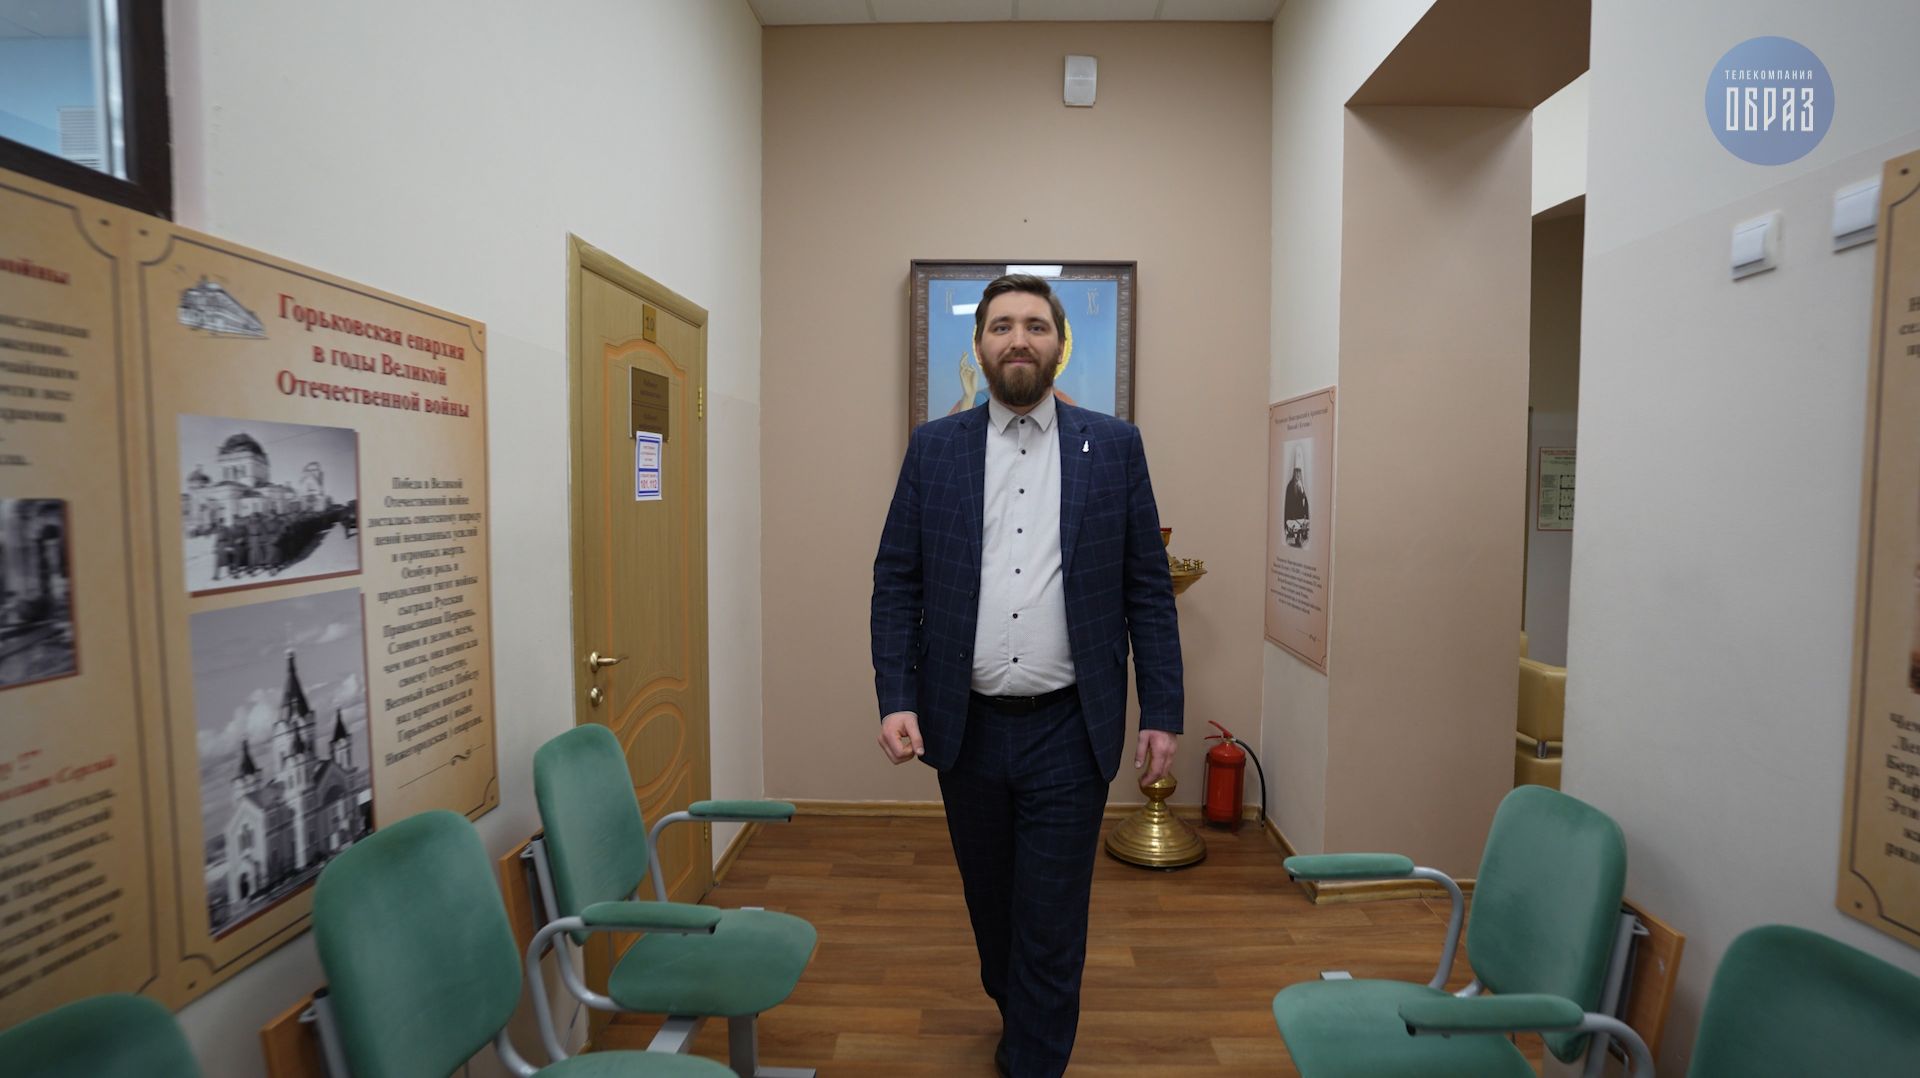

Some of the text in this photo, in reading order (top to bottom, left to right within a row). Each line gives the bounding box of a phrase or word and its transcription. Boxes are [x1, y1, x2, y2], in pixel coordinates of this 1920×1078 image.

[278, 293, 465, 361] Горьковская епархия
[312, 345, 447, 386] в годы Великой
[277, 370, 469, 418] Отечественной войны
[391, 477, 422, 489] Победа
[431, 477, 463, 489] Великой
[384, 495, 469, 508] Отечественной войне
[413, 514, 456, 525] советскому
[401, 565, 433, 579] Особую
[435, 594, 464, 610] Русская
[383, 616, 442, 639] Православная
[388, 639, 420, 655] Словом
